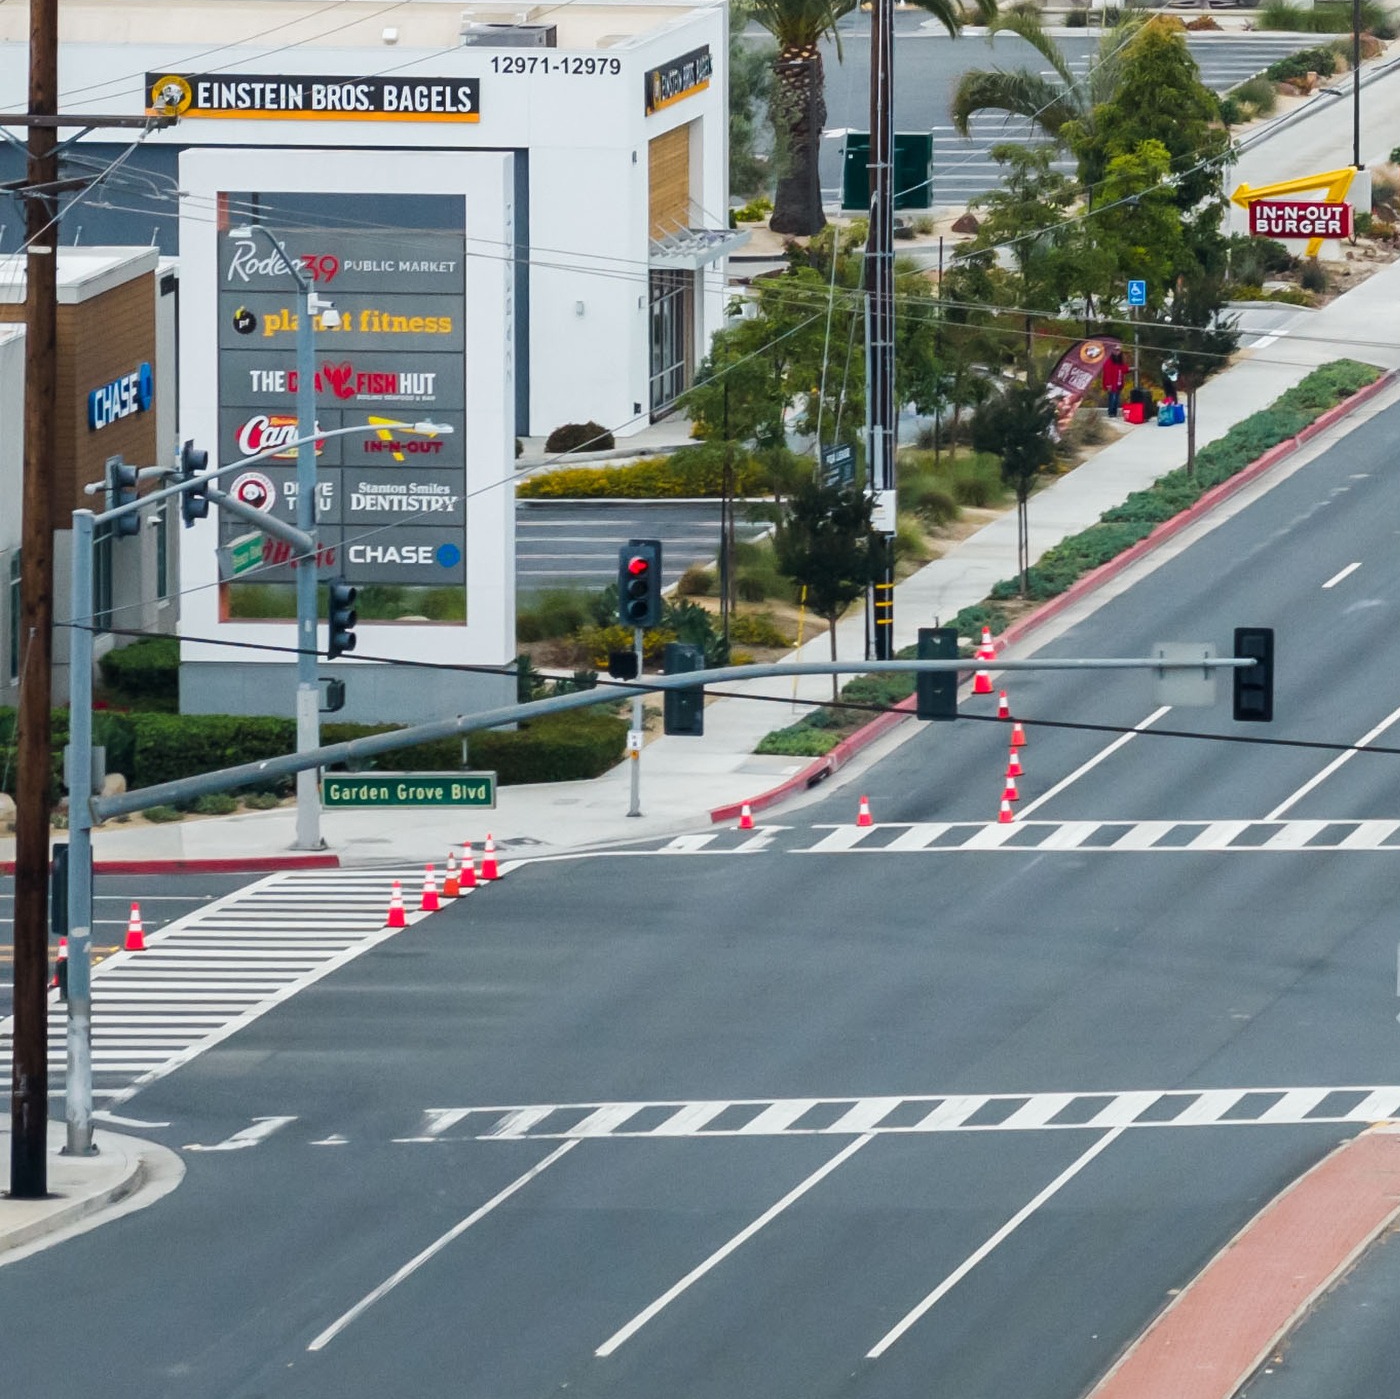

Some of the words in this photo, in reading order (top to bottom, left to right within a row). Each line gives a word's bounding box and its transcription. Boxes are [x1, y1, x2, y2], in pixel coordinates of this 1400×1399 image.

[490, 56, 621, 76] 12971-12979
[197, 81, 303, 111] EINSTEIN
[383, 84, 472, 113] BAGELS
[1255, 205, 1343, 220] IN-N-OUT
[1256, 219, 1341, 234] BURGER
[227, 240, 304, 283] Rodeo
[300, 254, 339, 283] 39
[344, 260, 395, 273] PUBLIC
[398, 260, 457, 273] MARKET
[360, 309, 453, 334] fitness
[250, 370, 286, 393] THE
[400, 372, 436, 395] HUT
[94, 372, 139, 430] CHASE
[364, 440, 444, 454] IN-N-OUT
[358, 482, 406, 494] Stanton
[410, 482, 451, 494] Smiles
[350, 493, 458, 512] DENTISTRY
[349, 546, 433, 564] CHASE
[330, 784, 389, 800] Garden
[397, 784, 444, 800] Grove
[451, 784, 486, 800] Blvd
